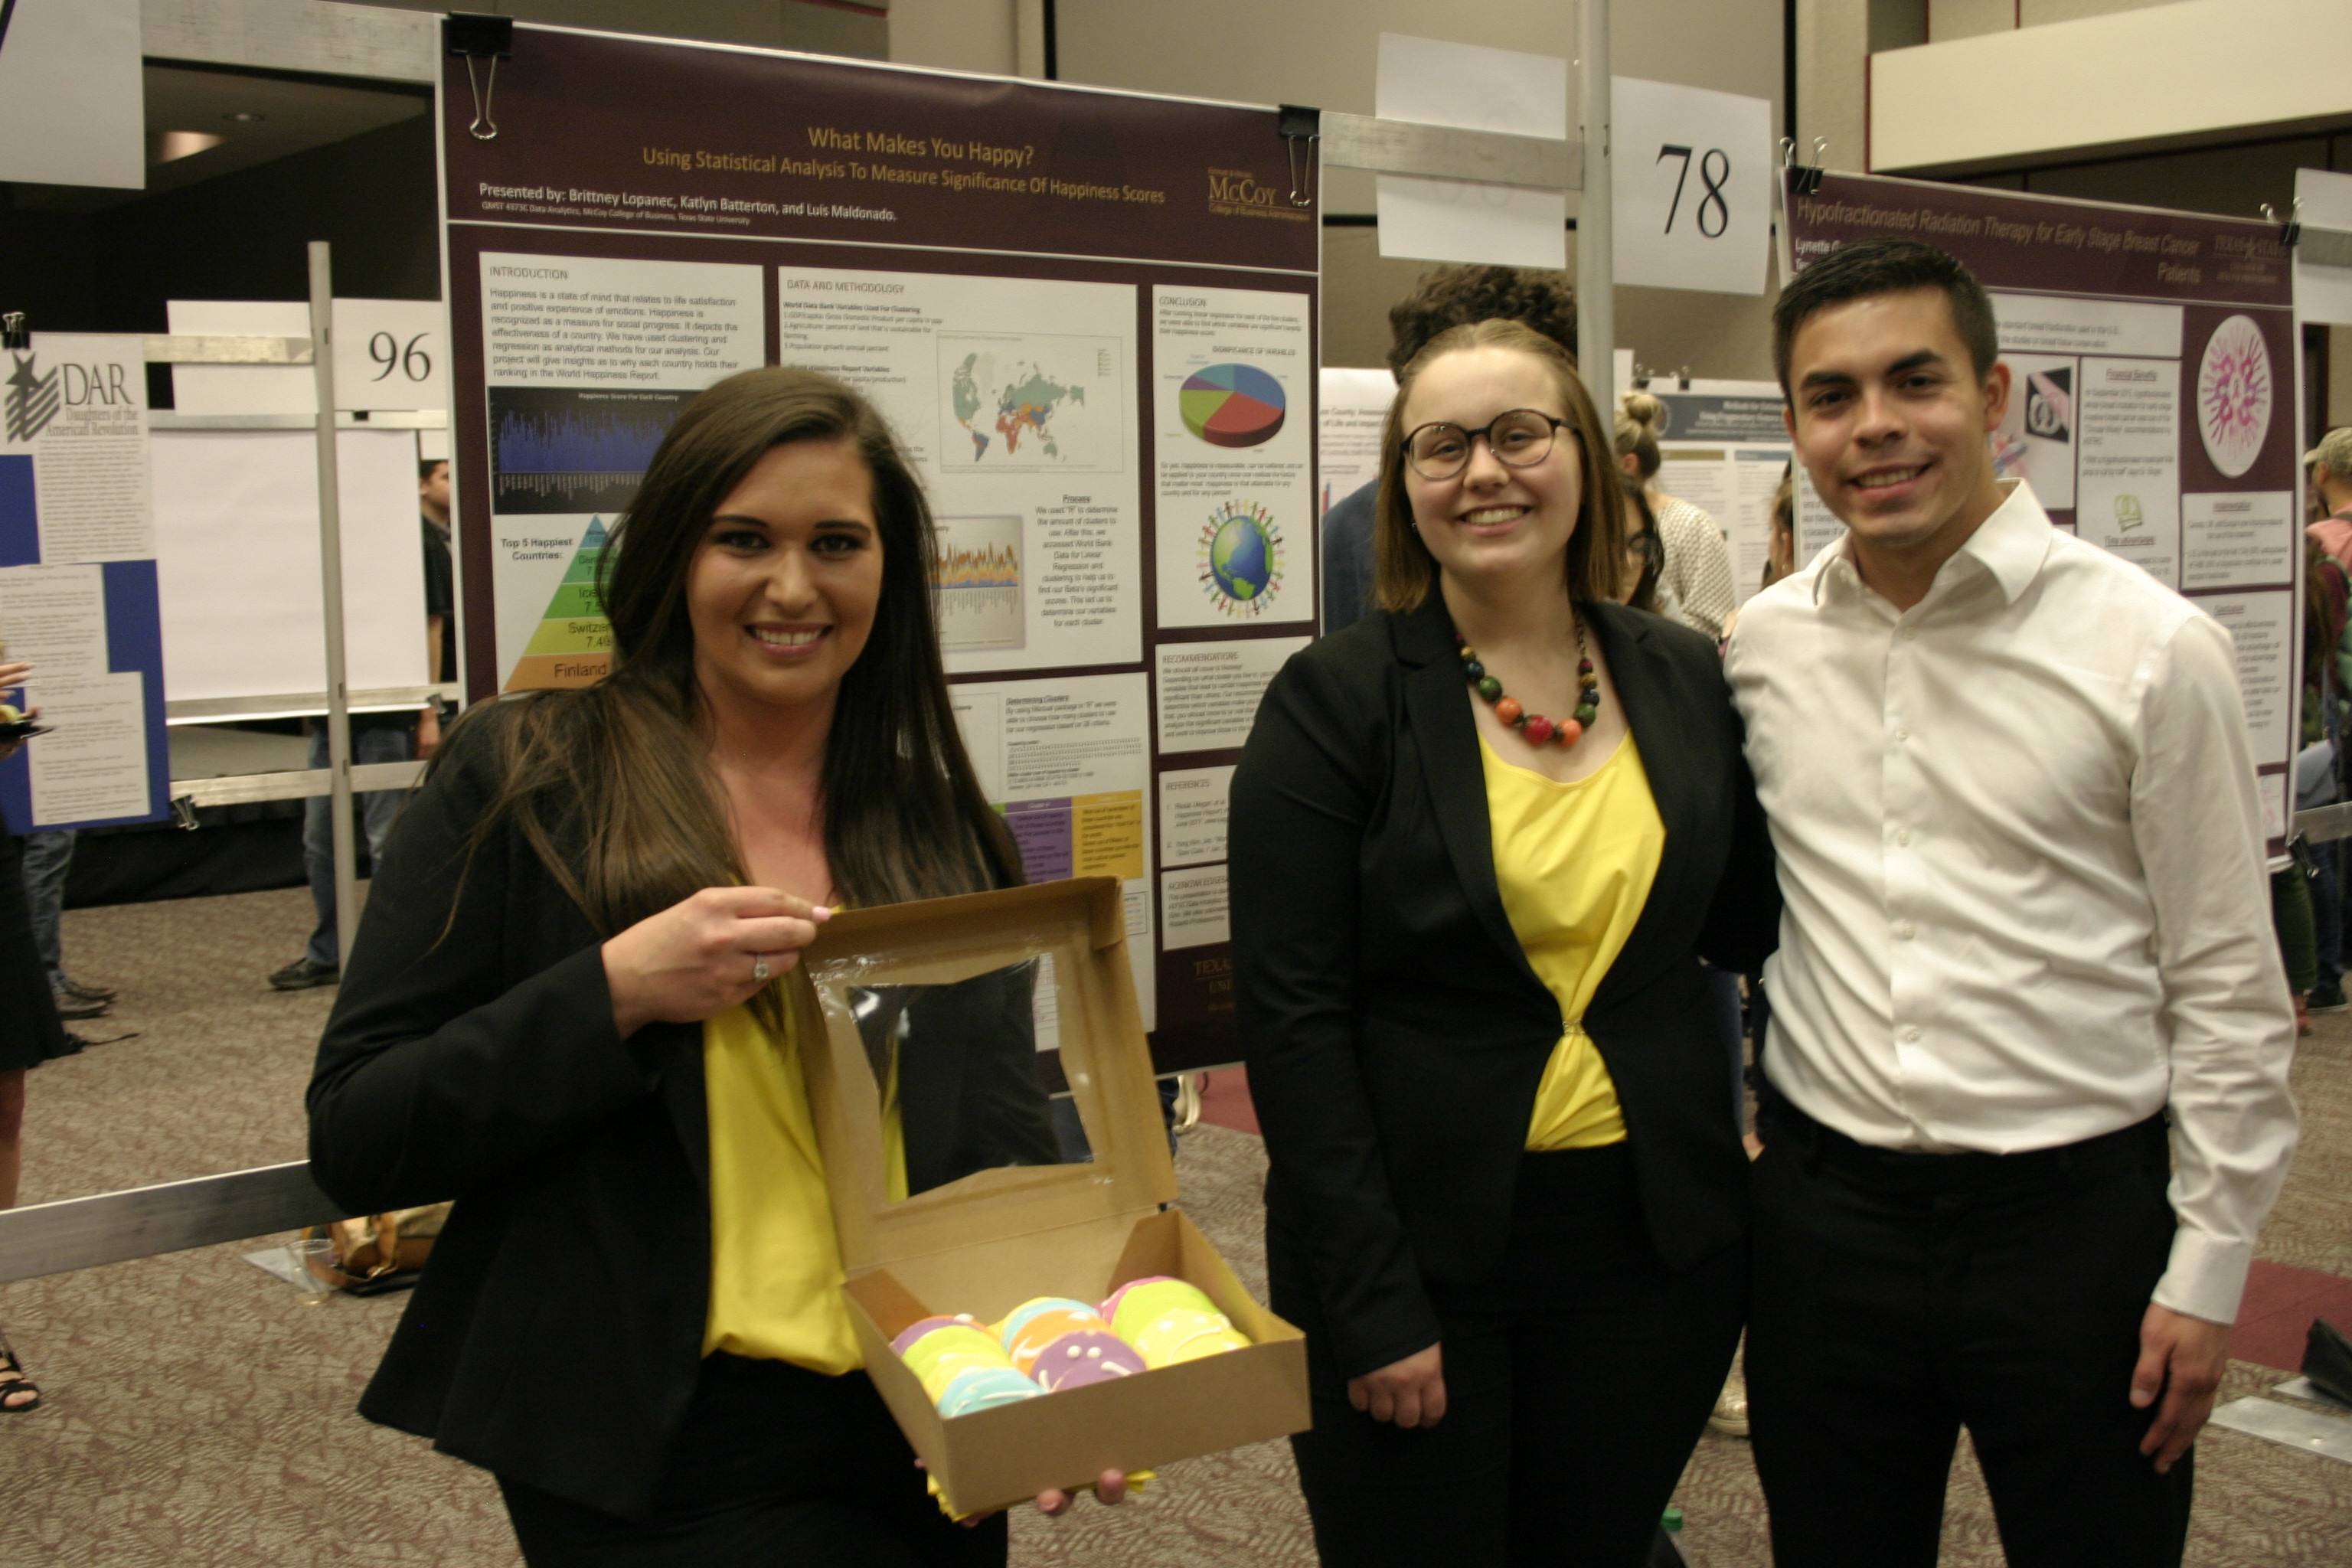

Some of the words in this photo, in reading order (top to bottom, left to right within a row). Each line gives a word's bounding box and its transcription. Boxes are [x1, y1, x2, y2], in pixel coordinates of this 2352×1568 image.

[808, 126, 861, 152] What
[866, 131, 927, 155] Makes
[931, 137, 963, 159] You
[969, 141, 1034, 168] Happy?
[642, 146, 692, 171] Using
[695, 150, 776, 173] Statistical
[780, 157, 844, 180] Analysis
[848, 161, 866, 180] To
[871, 164, 938, 185] Measure
[942, 169, 1027, 191] Significance
[1030, 176, 1047, 194] Of
[1050, 179, 1120, 201] Happiness
[1122, 185, 1166, 204] Scores
[1656, 144, 1730, 237] 78
[479, 182, 543, 200] Presented
[546, 186, 567, 204] by:
[569, 188, 620, 207] Brittney
[622, 192, 678, 210] Lopanec,
[680, 195, 717, 213] Katlyn
[720, 198, 779, 217] Batterton,
[782, 203, 803, 215] and
[806, 203, 829, 217] Luis
[831, 204, 897, 222] Maldonado.
[1797, 197, 1919, 229] Hypofractionated
[1919, 210, 1981, 235] Radiation
[1984, 216, 2033, 246] Therapy
[2035, 221, 2052, 244] for
[2054, 223, 2086, 250] Early
[2088, 227, 2122, 252] Stage
[2122, 230, 2161, 253] Breast
[2160, 234, 2201, 256] Cancer
[489, 266, 569, 281] INTRODUCTION
[2156, 261, 2202, 286] Patients
[786, 279, 809, 290] DATA
[812, 281, 832, 291] AND
[835, 282, 905, 294] METHODOLOGY
[490, 289, 537, 299] Happiness
[557, 292, 578, 301] state
[580, 292, 589, 301] of
[590, 292, 612, 302] mind
[613, 294, 630, 302] that
[664, 296, 671, 304] to
[491, 302, 508, 311] and
[595, 305, 604, 314] of
[649, 309, 694, 318] Happiness
[602, 318, 613, 327] for
[551, 329, 561, 338] of
[368, 332, 432, 383] 96
[61, 363, 135, 406] DAR
[501, 538, 521, 549] Top
[522, 537, 528, 546] 5
[531, 537, 573, 548] Happiest
[512, 550, 564, 560] Countries:
[554, 662, 607, 678] Finland
